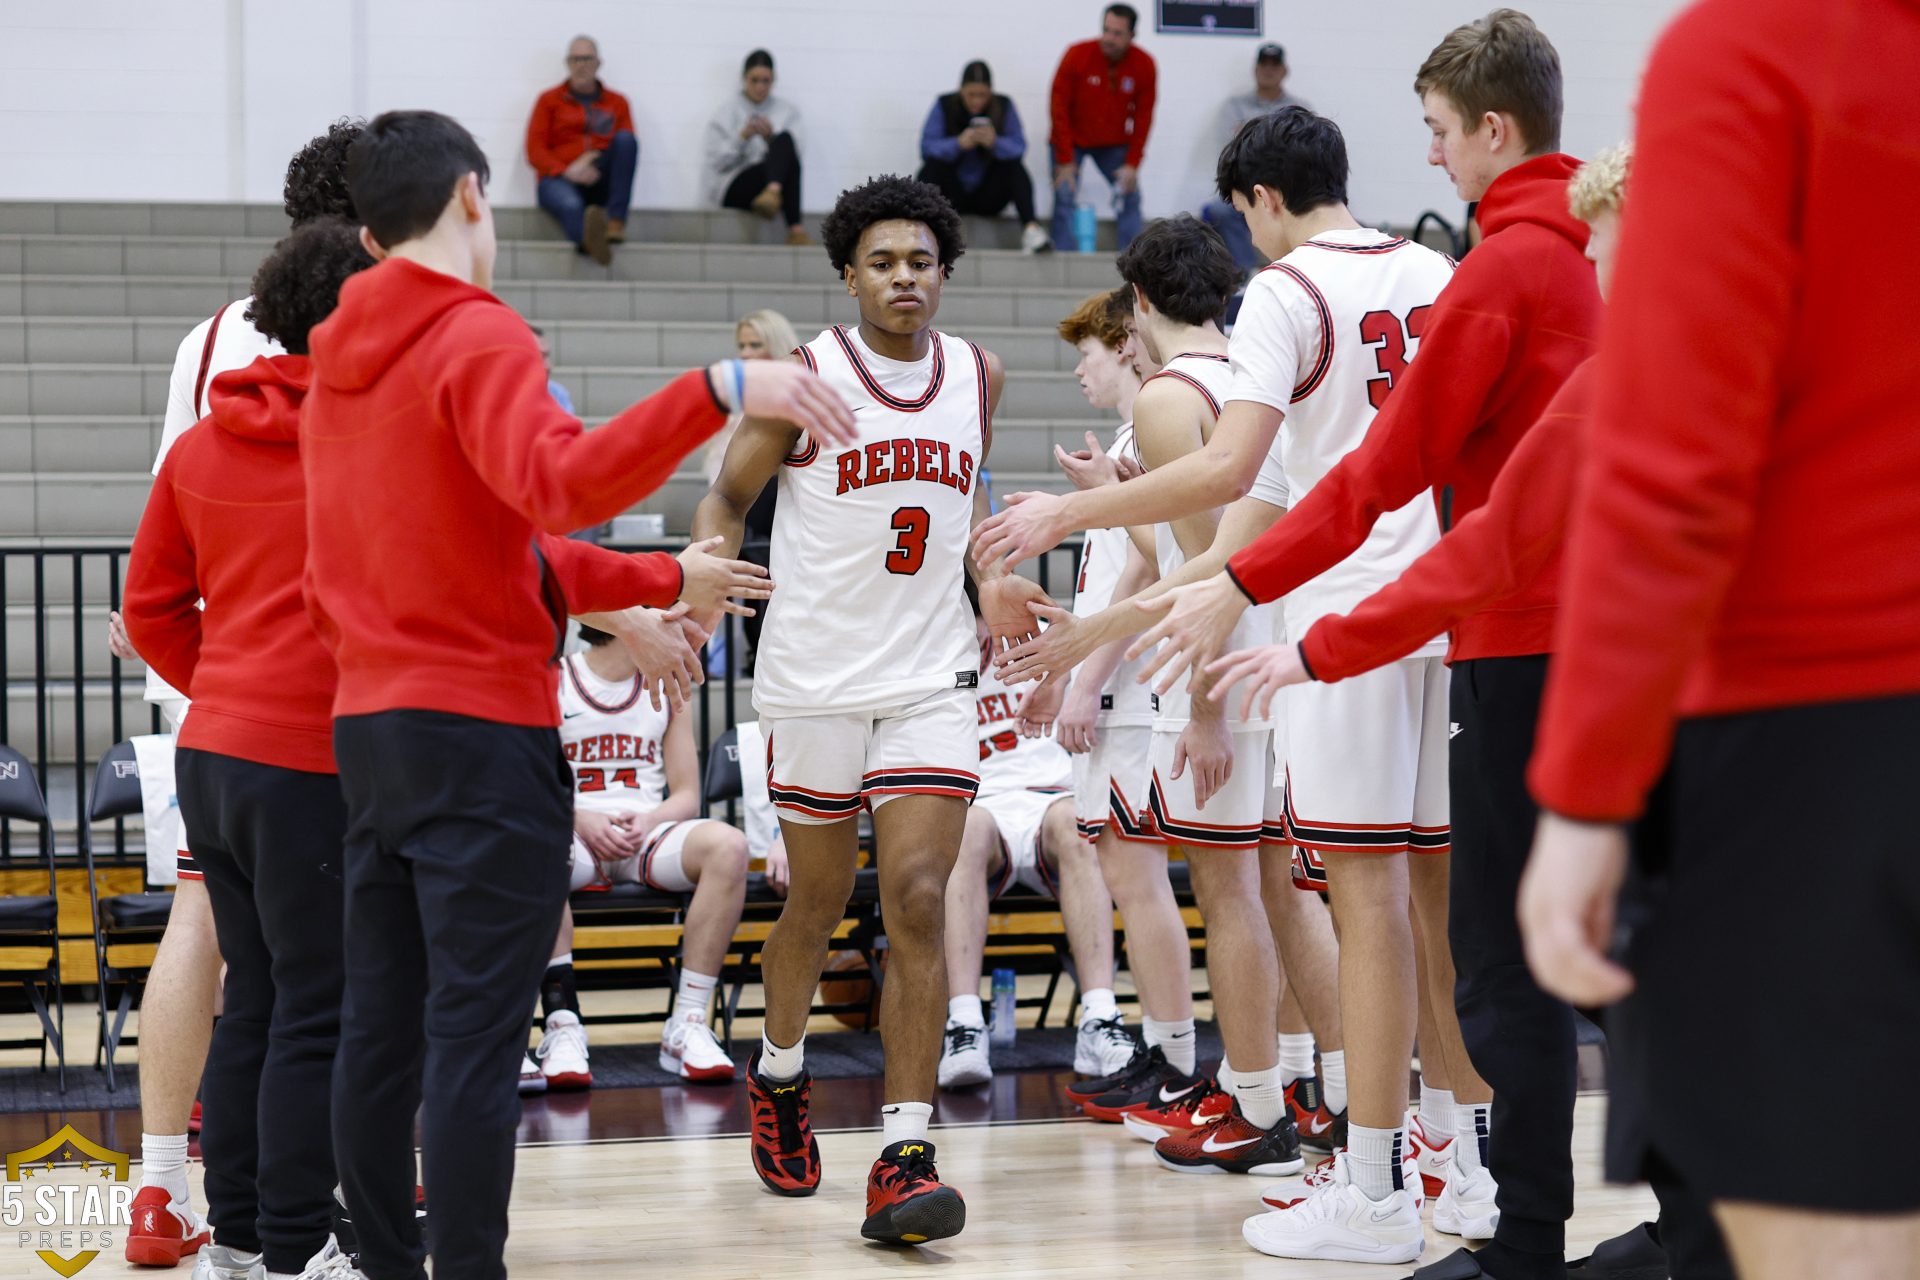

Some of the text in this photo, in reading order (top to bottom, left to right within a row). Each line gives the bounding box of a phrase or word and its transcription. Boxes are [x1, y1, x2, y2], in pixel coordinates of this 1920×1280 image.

[836, 438, 973, 496] REBELS
[885, 506, 930, 576] 3
[563, 733, 657, 764] REBELS
[577, 767, 641, 793] 24
